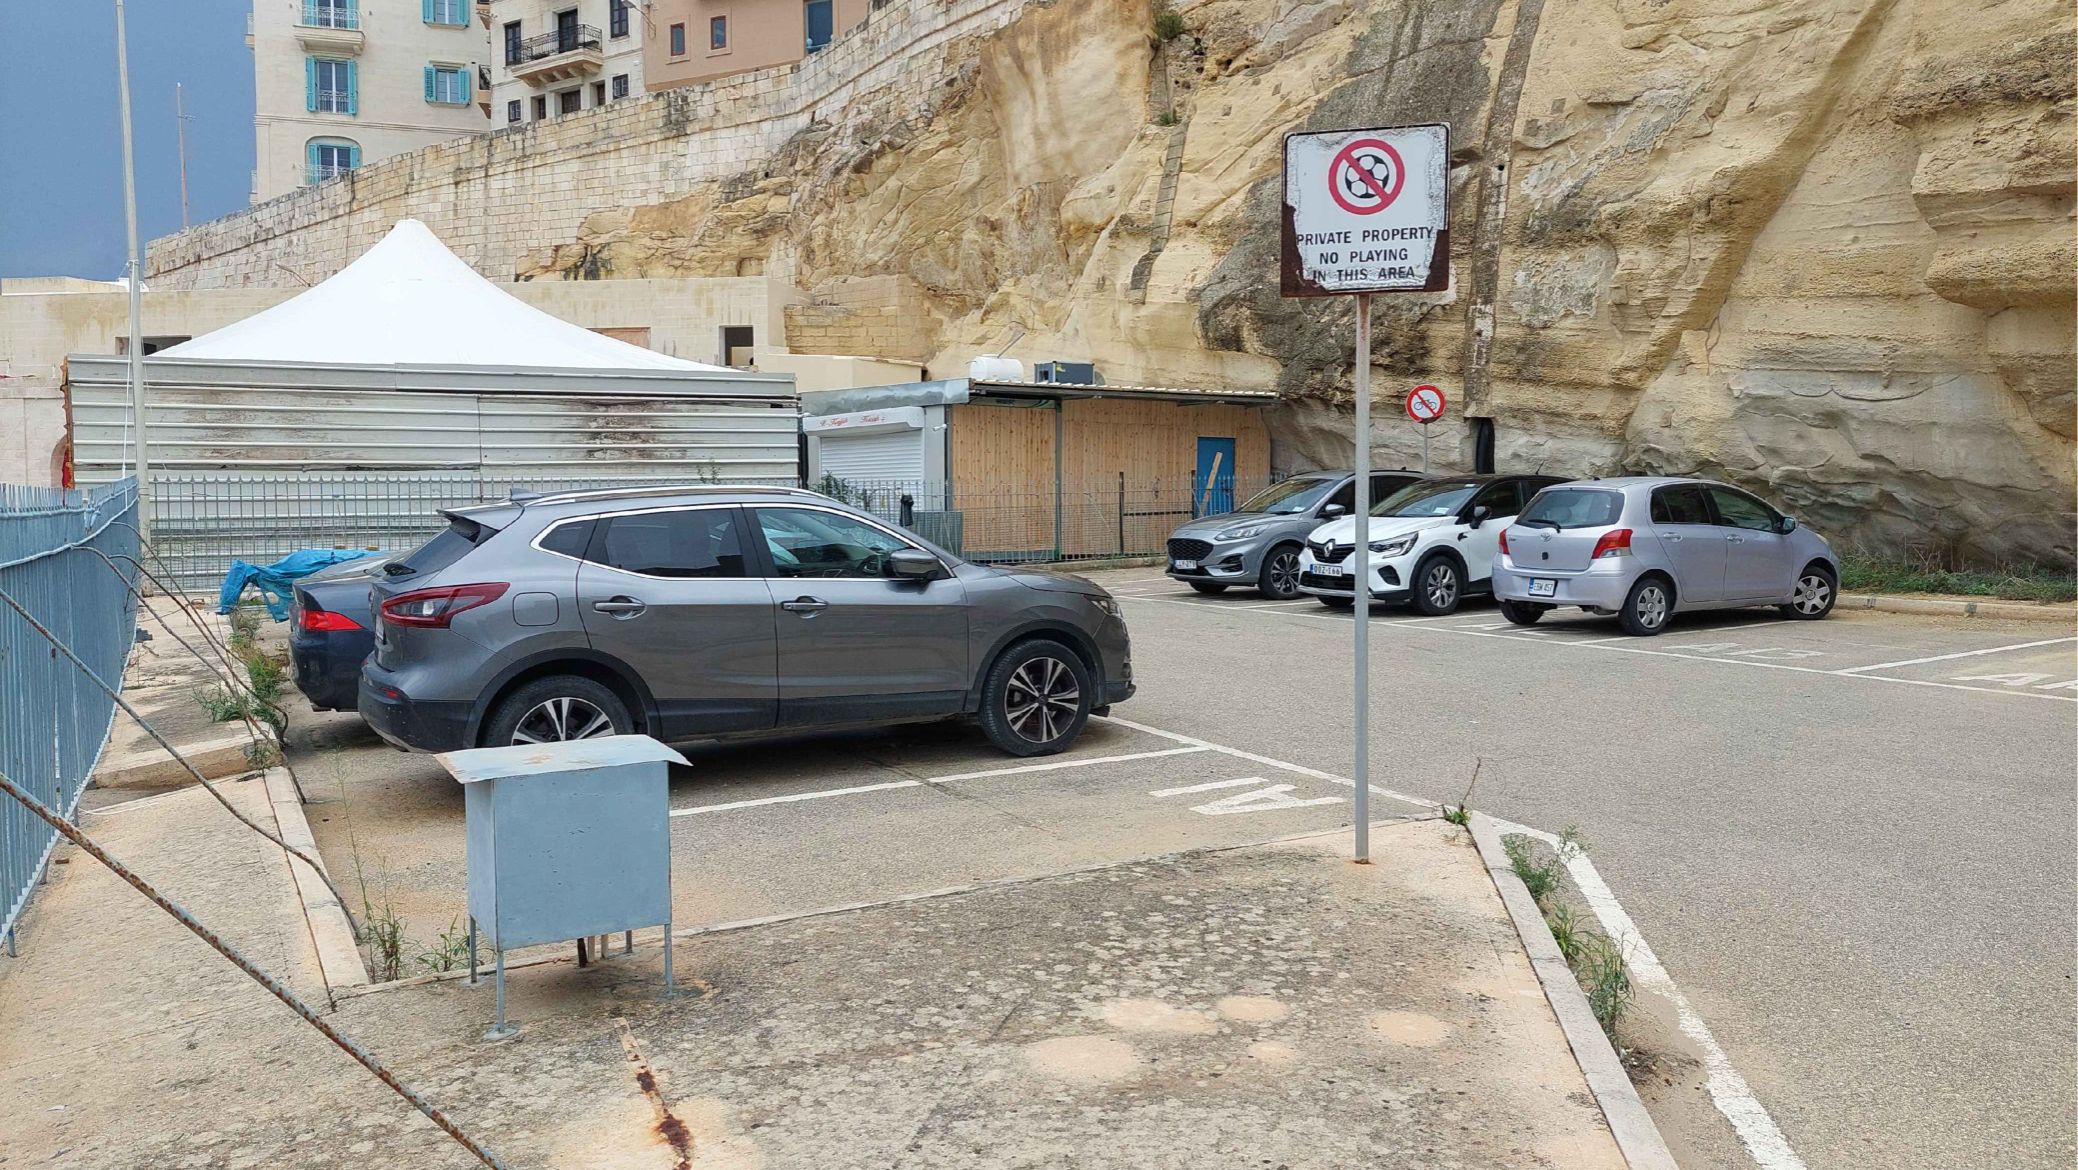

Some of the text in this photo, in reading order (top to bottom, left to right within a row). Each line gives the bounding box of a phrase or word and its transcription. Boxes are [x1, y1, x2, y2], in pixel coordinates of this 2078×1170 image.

[1297, 226, 1434, 246] PRIVATE PROPERTY
[1319, 248, 1408, 265] NO PLAYING
[1313, 266, 1415, 282] IN THIS AREA
